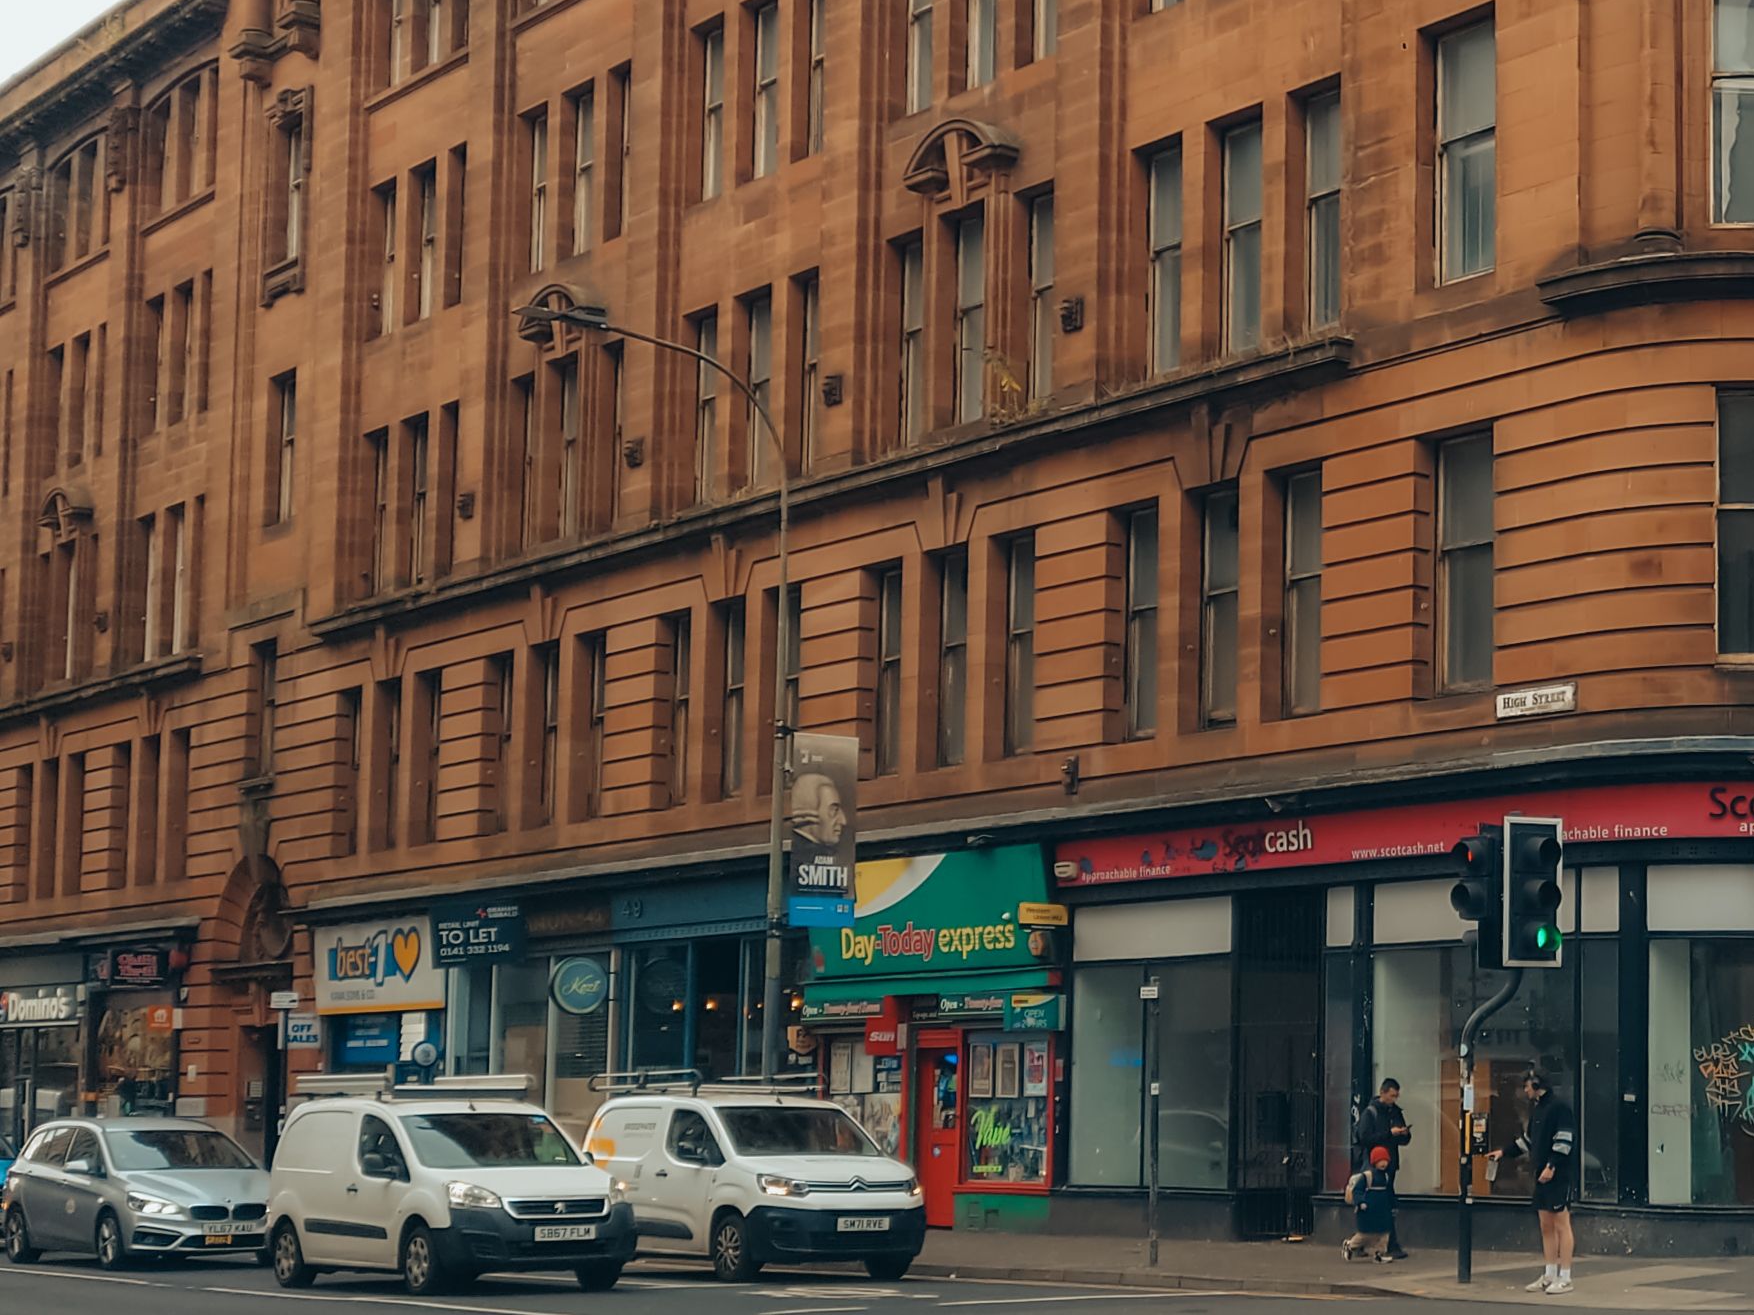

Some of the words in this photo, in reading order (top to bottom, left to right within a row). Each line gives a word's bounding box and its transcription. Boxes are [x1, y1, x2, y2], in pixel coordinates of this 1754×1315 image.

[1614, 824, 1668, 838] finance
[1351, 841, 1445, 860] www.scotcash.net
[814, 855, 833, 865] ADAM
[799, 865, 848, 887] SMITH
[1081, 865, 1137, 883] approachable
[1139, 864, 1171, 877] finance
[439, 930, 464, 944] TO
[470, 927, 497, 943] LET
[841, 922, 934, 966] Day-Today
[938, 922, 1015, 960] express
[440, 947, 464, 956] 0141
[467, 946, 485, 954] 332
[8, 992, 71, 1022] Domino's
[292, 1024, 312, 1033] OFF
[869, 1030, 895, 1042] Sun
